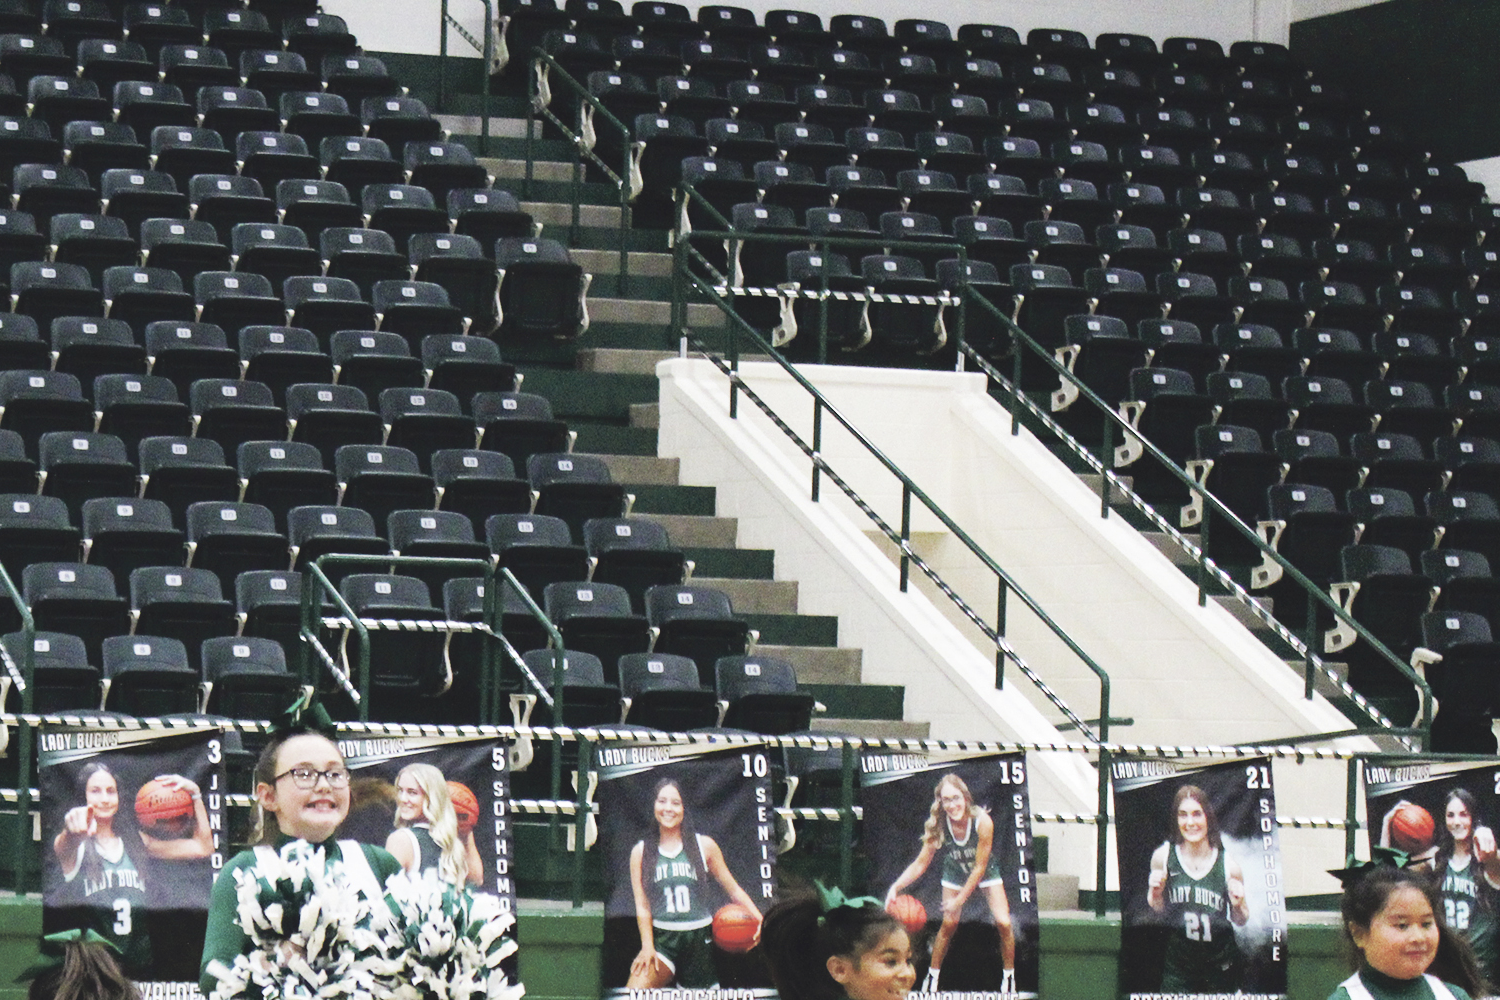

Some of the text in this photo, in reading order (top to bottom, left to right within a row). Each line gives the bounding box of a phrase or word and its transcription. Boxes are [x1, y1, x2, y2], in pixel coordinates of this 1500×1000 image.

[41, 731, 119, 752] LADY BUCKS
[207, 739, 221, 764] 3
[338, 738, 407, 758] ADY BUCKS
[492, 747, 506, 771] 5
[599, 746, 670, 767] LADY BUCKS
[741, 753, 768, 778] 10
[861, 754, 929, 773] LADY BUCKS
[999, 761, 1025, 785] 15
[1112, 762, 1138, 780] LADY
[1246, 766, 1272, 790] 21
[1366, 765, 1431, 784] LADY BUCKS
[756, 787, 774, 898] SENIOR
[1012, 794, 1031, 903] SENIOR
[1259, 798, 1283, 963] SOPHOMORE
[663, 884, 691, 913] 10
[112, 898, 132, 936] 3
[1183, 911, 1212, 942] 21
